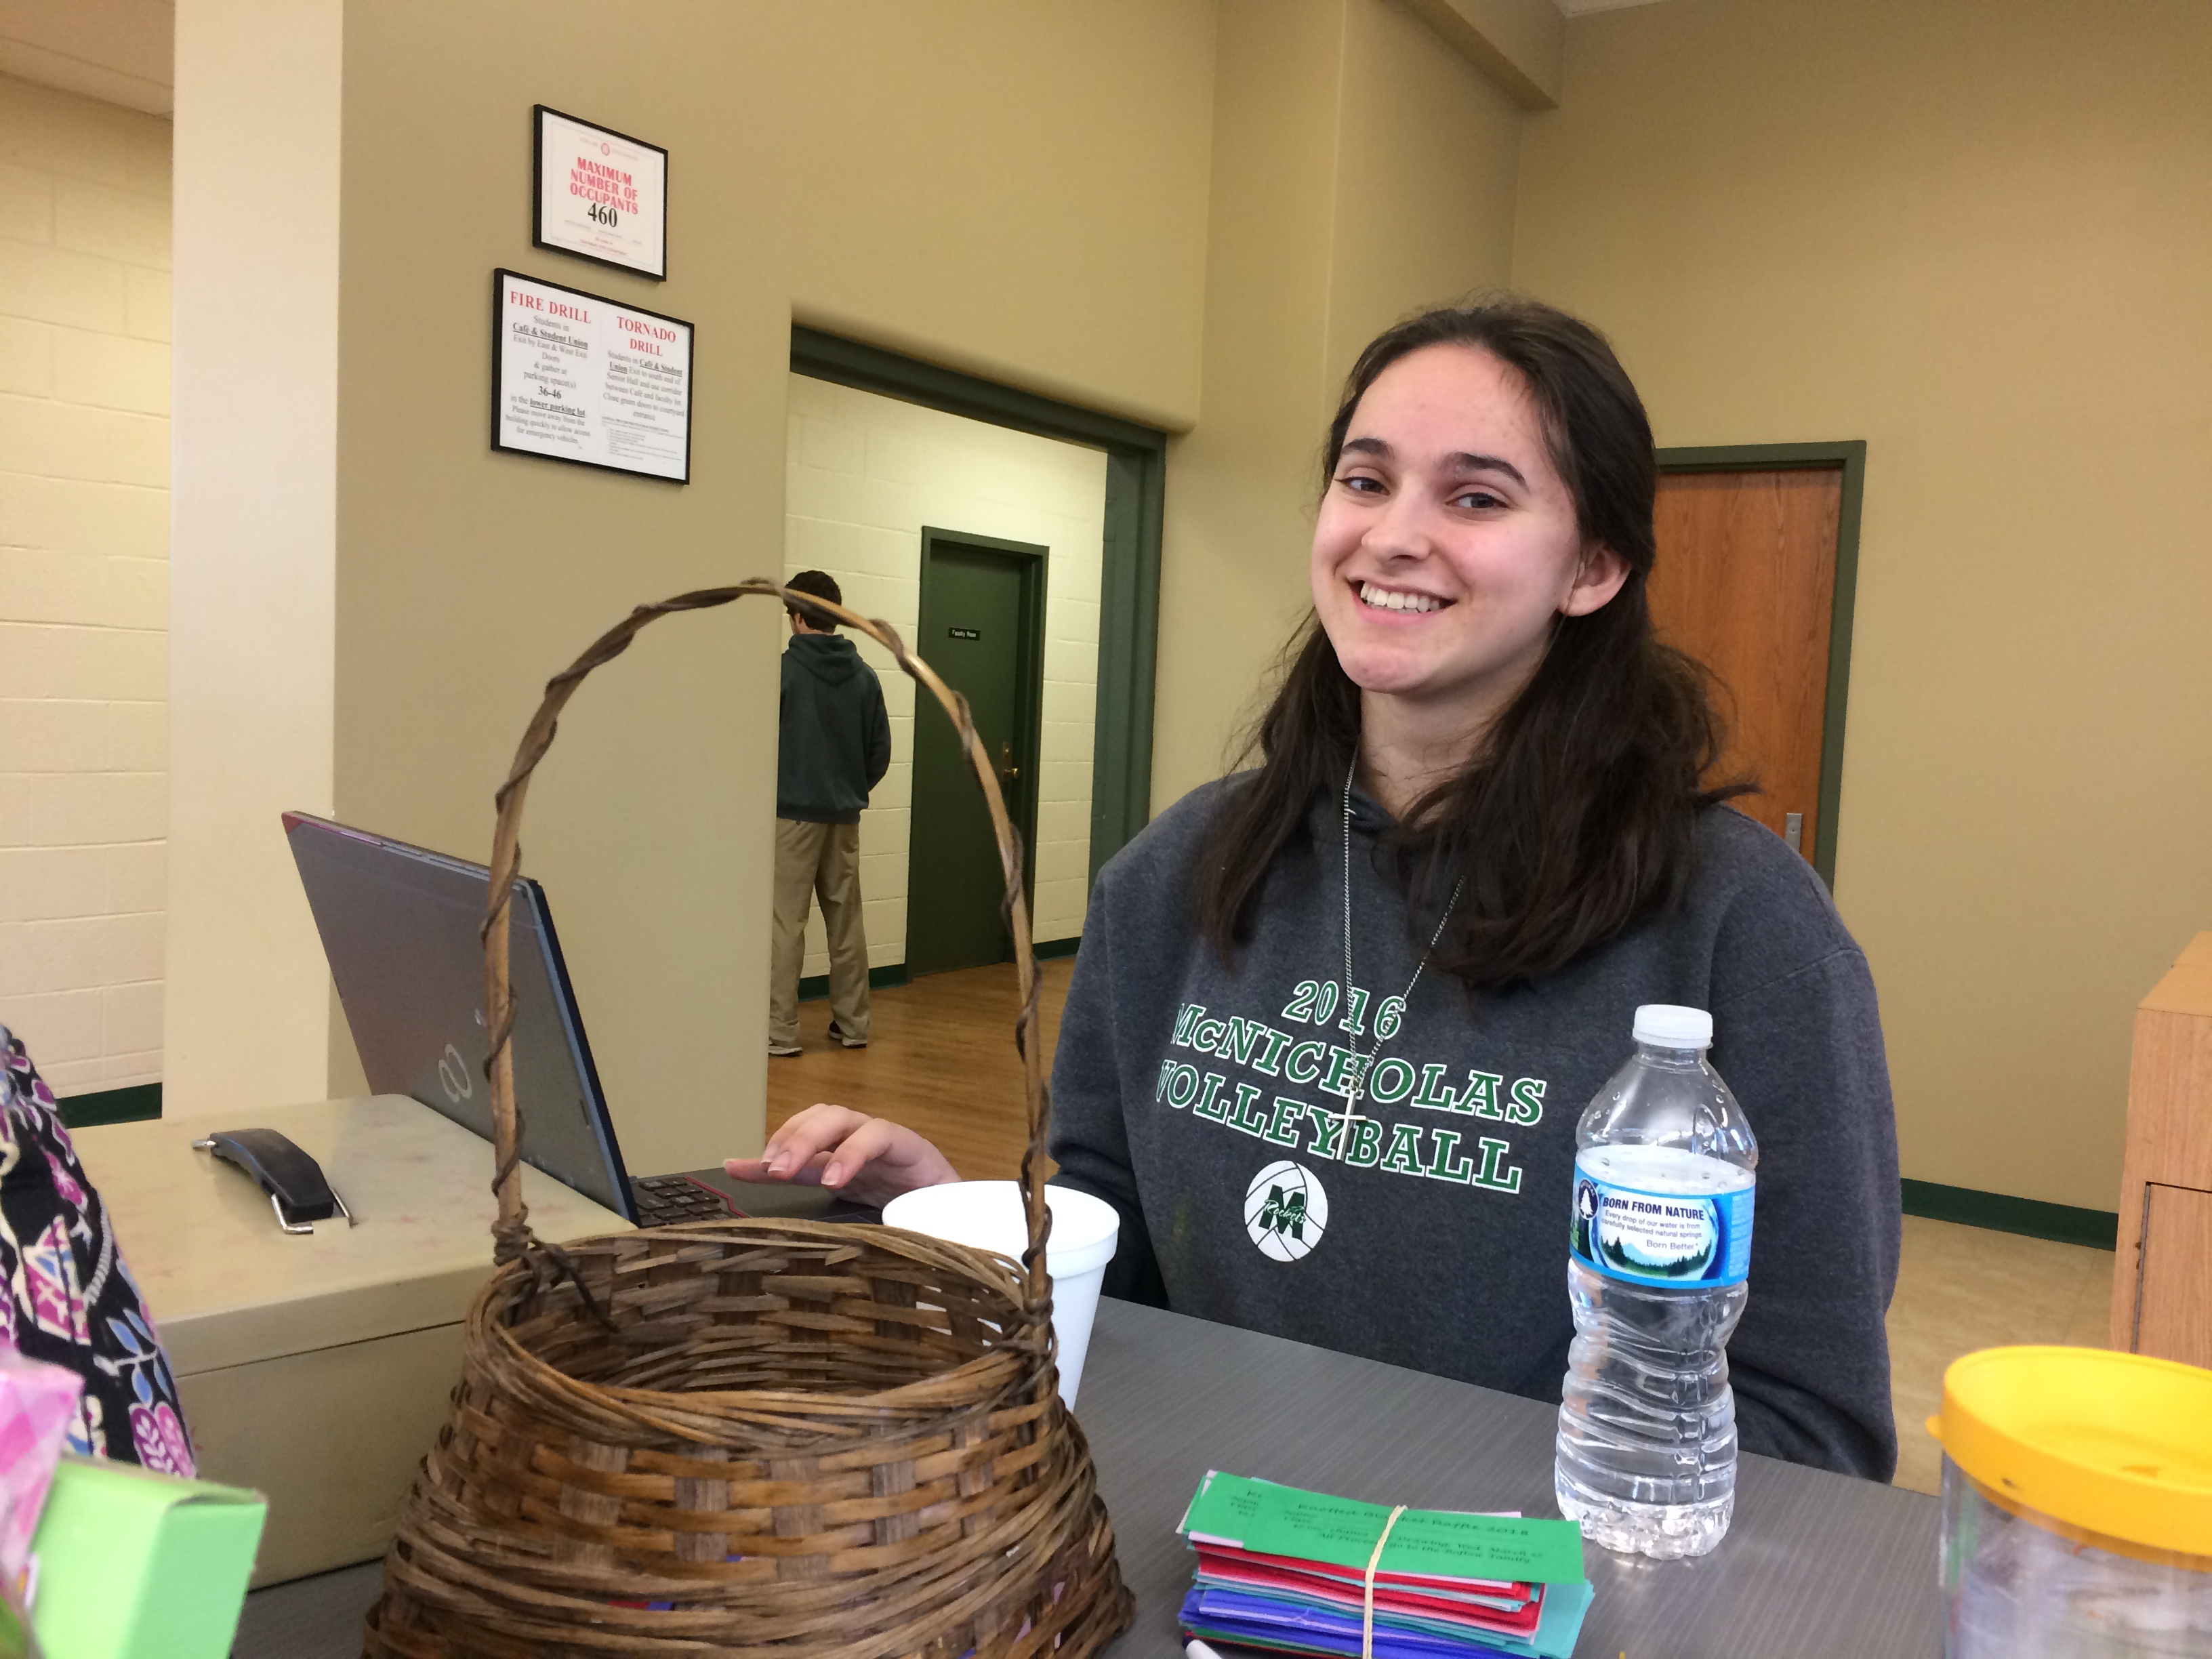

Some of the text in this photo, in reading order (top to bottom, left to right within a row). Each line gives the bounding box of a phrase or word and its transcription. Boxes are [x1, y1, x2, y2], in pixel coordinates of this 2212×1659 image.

[577, 157, 632, 186] MAXIMUM
[571, 169, 638, 201] NUMBER OF
[570, 182, 638, 215] OCCUPANTS
[588, 203, 617, 228] 460
[510, 291, 591, 324] FIRE DRILL
[533, 315, 562, 329] Students
[617, 316, 676, 343] TORNADO
[514, 333, 527, 344] Exit
[528, 336, 535, 347] by
[552, 344, 557, 352] &
[559, 345, 573, 355] West
[531, 327, 537, 335] &
[540, 329, 567, 343] Student
[569, 336, 588, 348] Union
[630, 338, 663, 356] DRILL
[533, 361, 539, 369] &
[542, 352, 560, 363] Doors
[609, 361, 628, 372] Union
[524, 371, 548, 384] parking
[661, 365, 682, 375] Student
[518, 396, 528, 405] the
[530, 398, 548, 409] lower
[550, 403, 575, 416] parking
[1281, 980, 1406, 1040] 2016
[1170, 1002, 1547, 1126] McNICHOLAS
[1156, 1059, 1522, 1193] VOLLEYBALL
[1264, 1199, 1307, 1224] Rockets
[1603, 1197, 1704, 1220] BORN FROM NATURE
[1605, 1209, 1621, 1221] Every
[1622, 1215, 1637, 1225] drop
[1601, 1218, 1625, 1230] carefully
[1626, 1224, 1654, 1235] selected
[1655, 1229, 1678, 1237] natural
[1646, 1240, 1667, 1249] Born
[1432, 1519, 1481, 1530] Raffle
